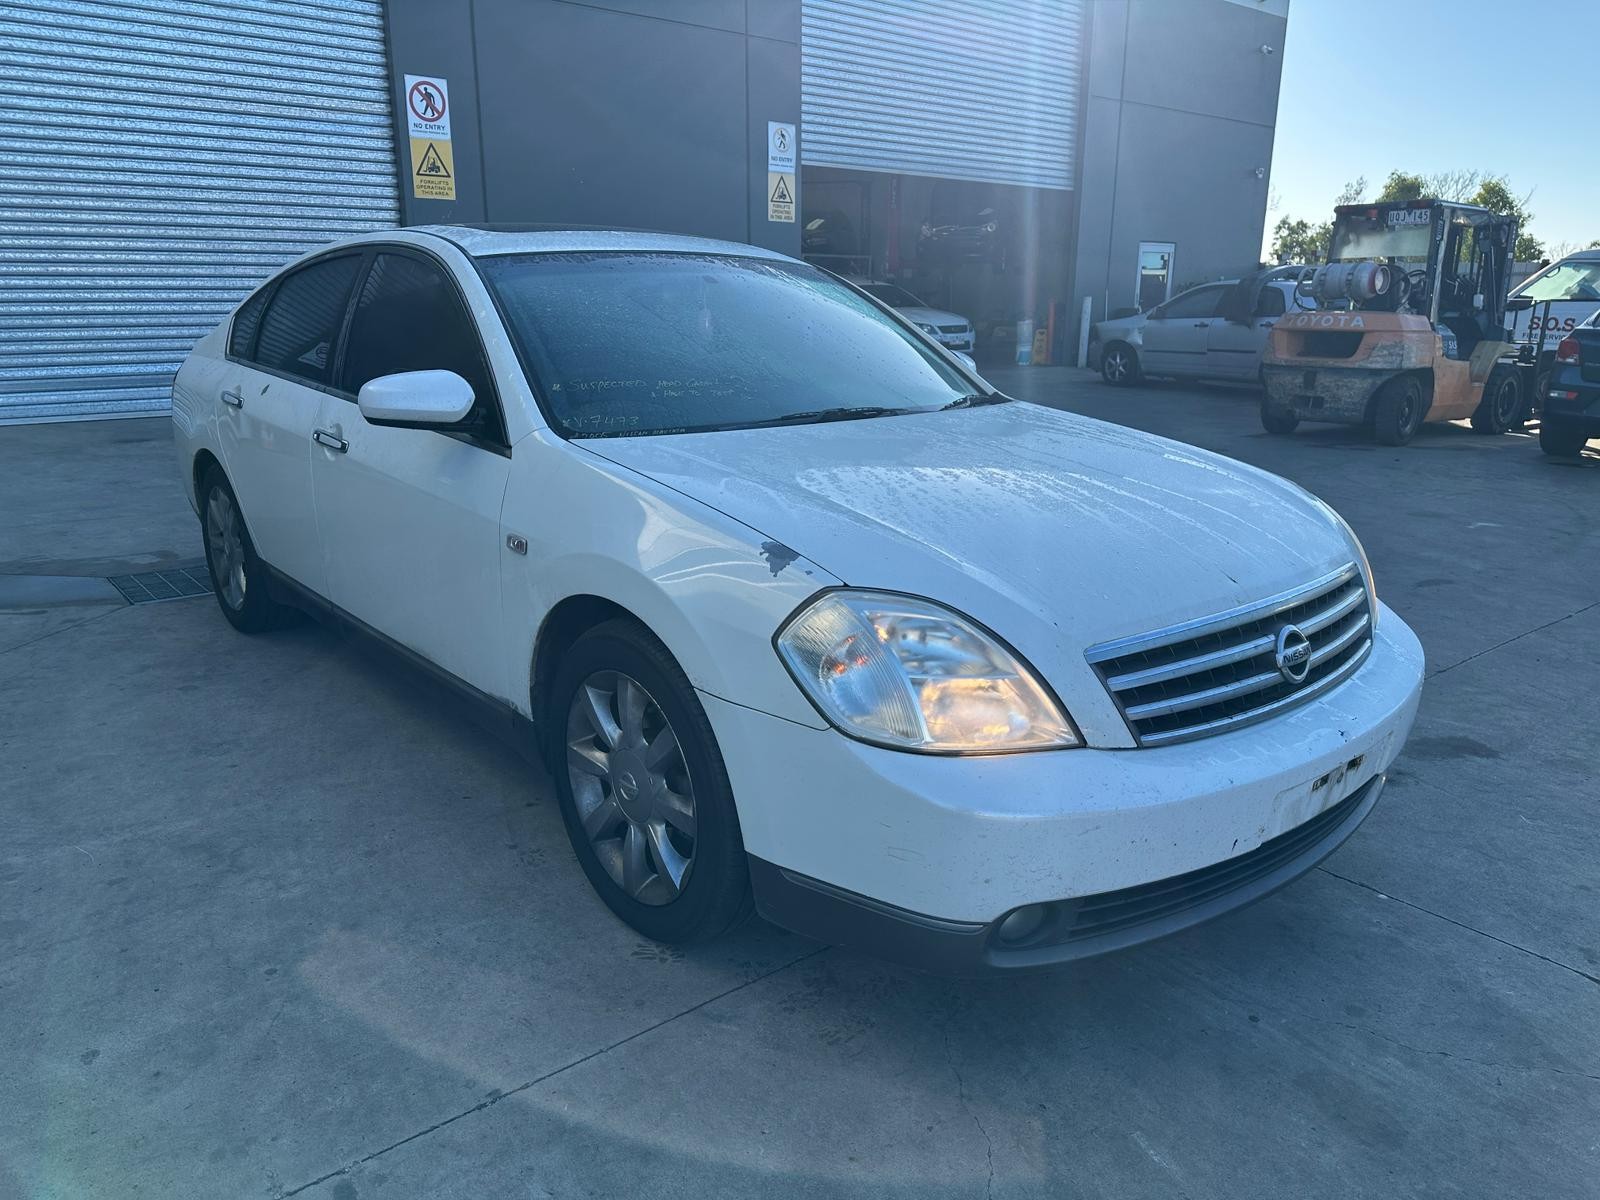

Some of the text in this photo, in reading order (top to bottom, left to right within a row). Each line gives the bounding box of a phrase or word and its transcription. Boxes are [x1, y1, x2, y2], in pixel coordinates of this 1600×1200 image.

[425, 123, 446, 131] ENTRY
[1413, 210, 1429, 221] 145
[1286, 315, 1364, 328] TOYOTA
[1528, 316, 1576, 332] SO.S
[1283, 646, 1311, 663] NISSAN
